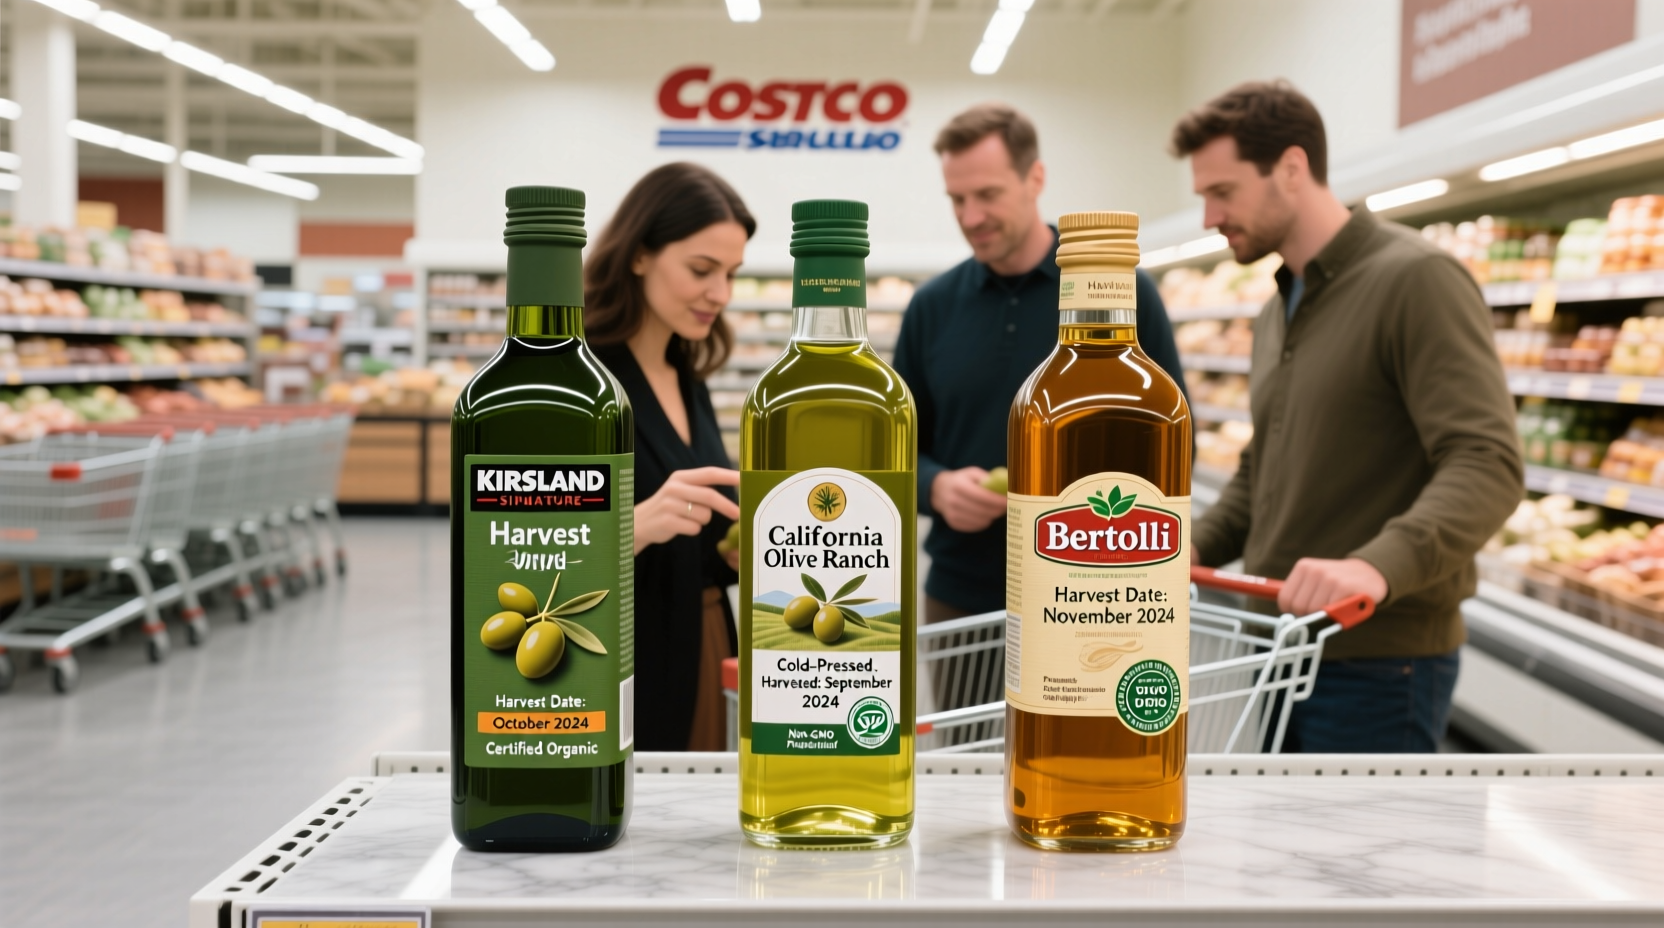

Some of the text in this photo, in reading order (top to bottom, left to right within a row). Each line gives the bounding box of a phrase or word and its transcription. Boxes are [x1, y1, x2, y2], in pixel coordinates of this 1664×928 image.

[477, 469, 605, 492] KIRSLAND
[490, 521, 591, 546] Harvest
[768, 525, 884, 547] California
[1046, 521, 1171, 551] Bertolli
[764, 548, 890, 569] Olive Ranch
[1055, 586, 1168, 603] Harvest Date:
[1043, 606, 1175, 624] November 2024
[824, 675, 893, 693] September
[495, 694, 586, 708] Harvest Date:
[802, 695, 840, 708] 2024
[492, 716, 589, 730] October 2024
[485, 741, 598, 759] Certified Organic
